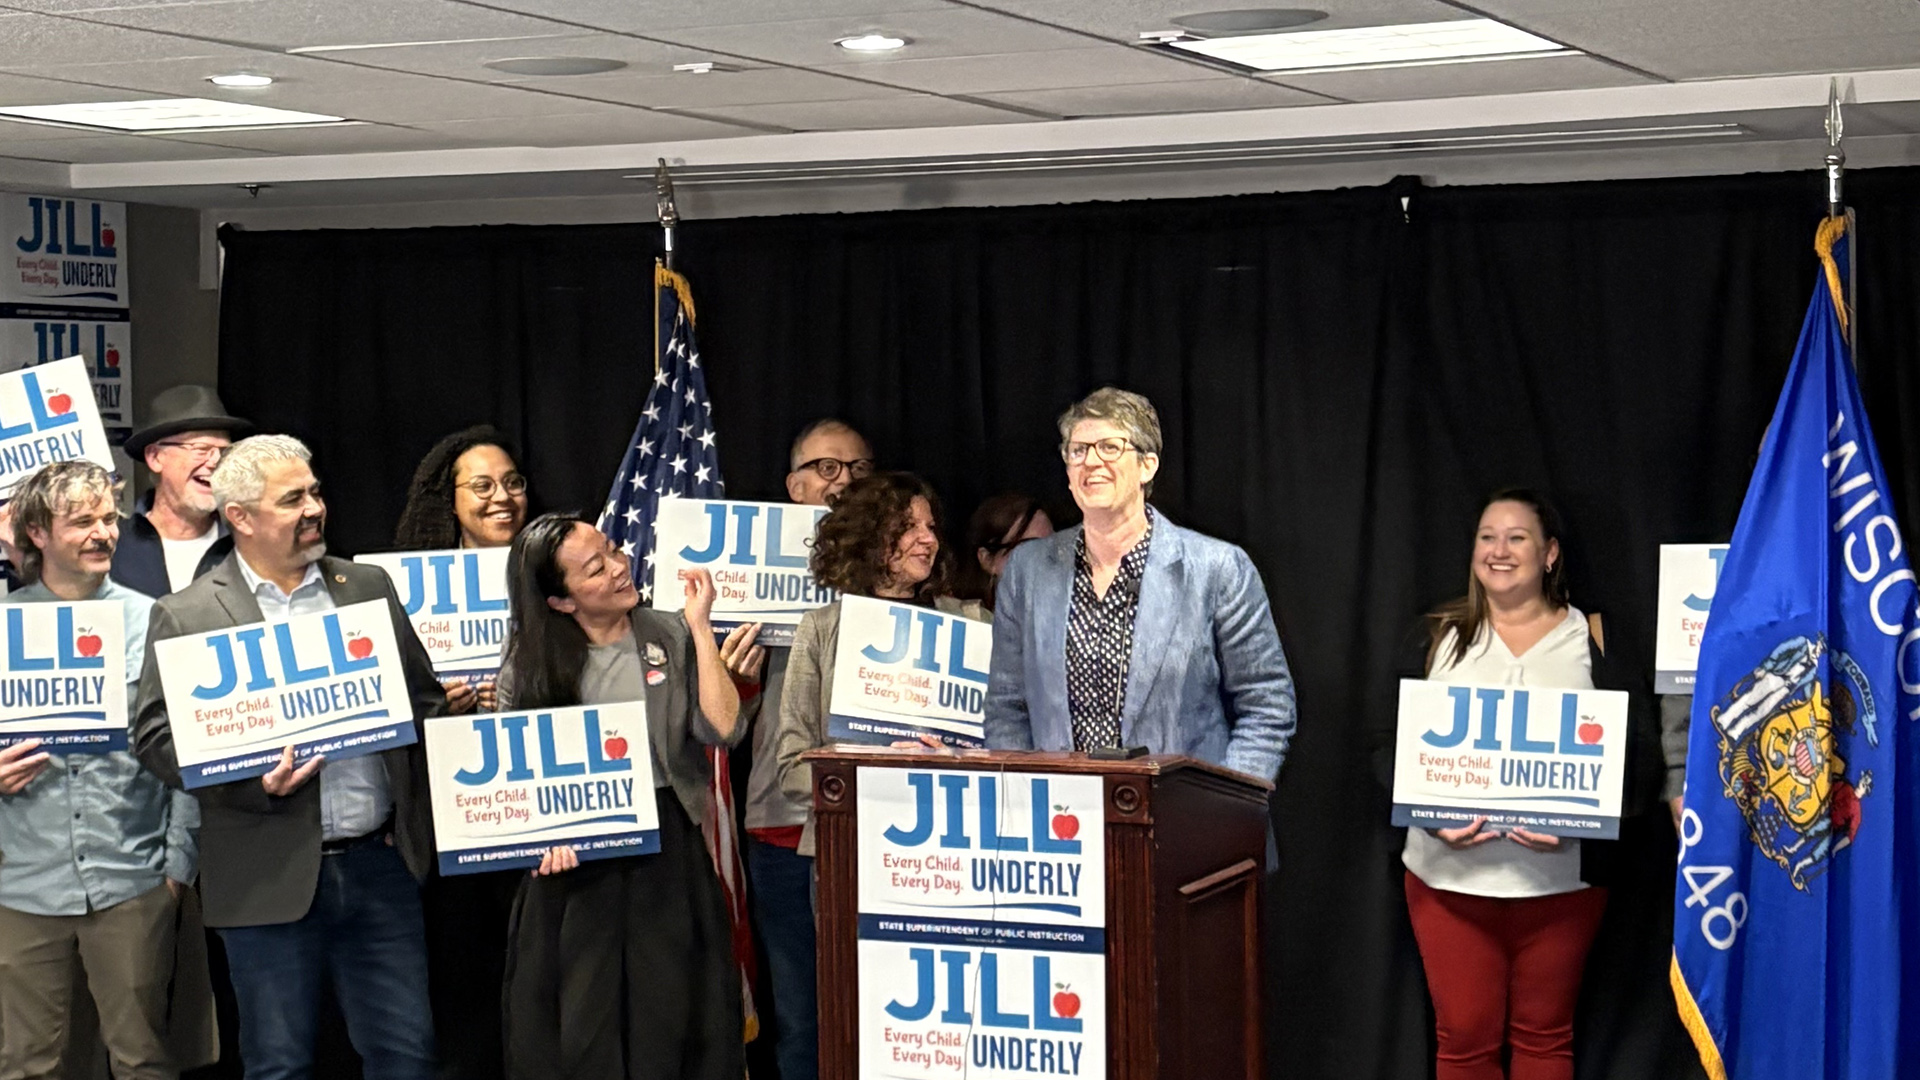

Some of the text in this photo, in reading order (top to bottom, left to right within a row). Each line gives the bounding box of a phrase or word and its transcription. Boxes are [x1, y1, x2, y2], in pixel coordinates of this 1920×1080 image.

[16, 197, 117, 258] JILL
[62, 260, 117, 288] UNDERLY
[0, 429, 85, 476] NDERLY
[678, 503, 828, 569] JIL
[715, 570, 749, 583] Child.
[722, 586, 749, 603] Day.
[419, 620, 453, 634] Child.
[460, 618, 508, 646] UND
[191, 613, 379, 701] JILL
[428, 637, 454, 652] Day.
[858, 666, 933, 689] Every Child.
[1, 676, 106, 708] UNDERLY
[280, 674, 384, 720] UNDERLY
[864, 682, 932, 708] Every Day.
[938, 680, 986, 715] UND
[195, 696, 274, 723] Every Child.
[1421, 685, 1605, 757] JILL
[206, 714, 277, 738] Every Day.
[313, 742, 342, 754] PUBLIC
[453, 709, 632, 786] JILL
[1419, 752, 1494, 771] Every Child.
[1426, 769, 1493, 789] Every Day.
[1500, 758, 1604, 792] UNDERLY
[455, 788, 530, 810] Every Child.
[536, 778, 635, 816] UNDERLY
[465, 806, 533, 825] Every Day.
[883, 772, 1082, 855] JILL
[1518, 816, 1547, 826] PUBLIC
[883, 853, 964, 874] Every Child.
[891, 872, 964, 895] Every Day.
[971, 857, 1082, 897] UNDERLY
[879, 921, 1085, 942] STATE SUPERINTENDENT OF PUBLIC INSTRUCTION
[884, 947, 1083, 1033] JILL
[884, 1027, 965, 1049] Every Child.
[892, 1047, 931, 1069] Every
[973, 1034, 1083, 1076] UNDERLY
